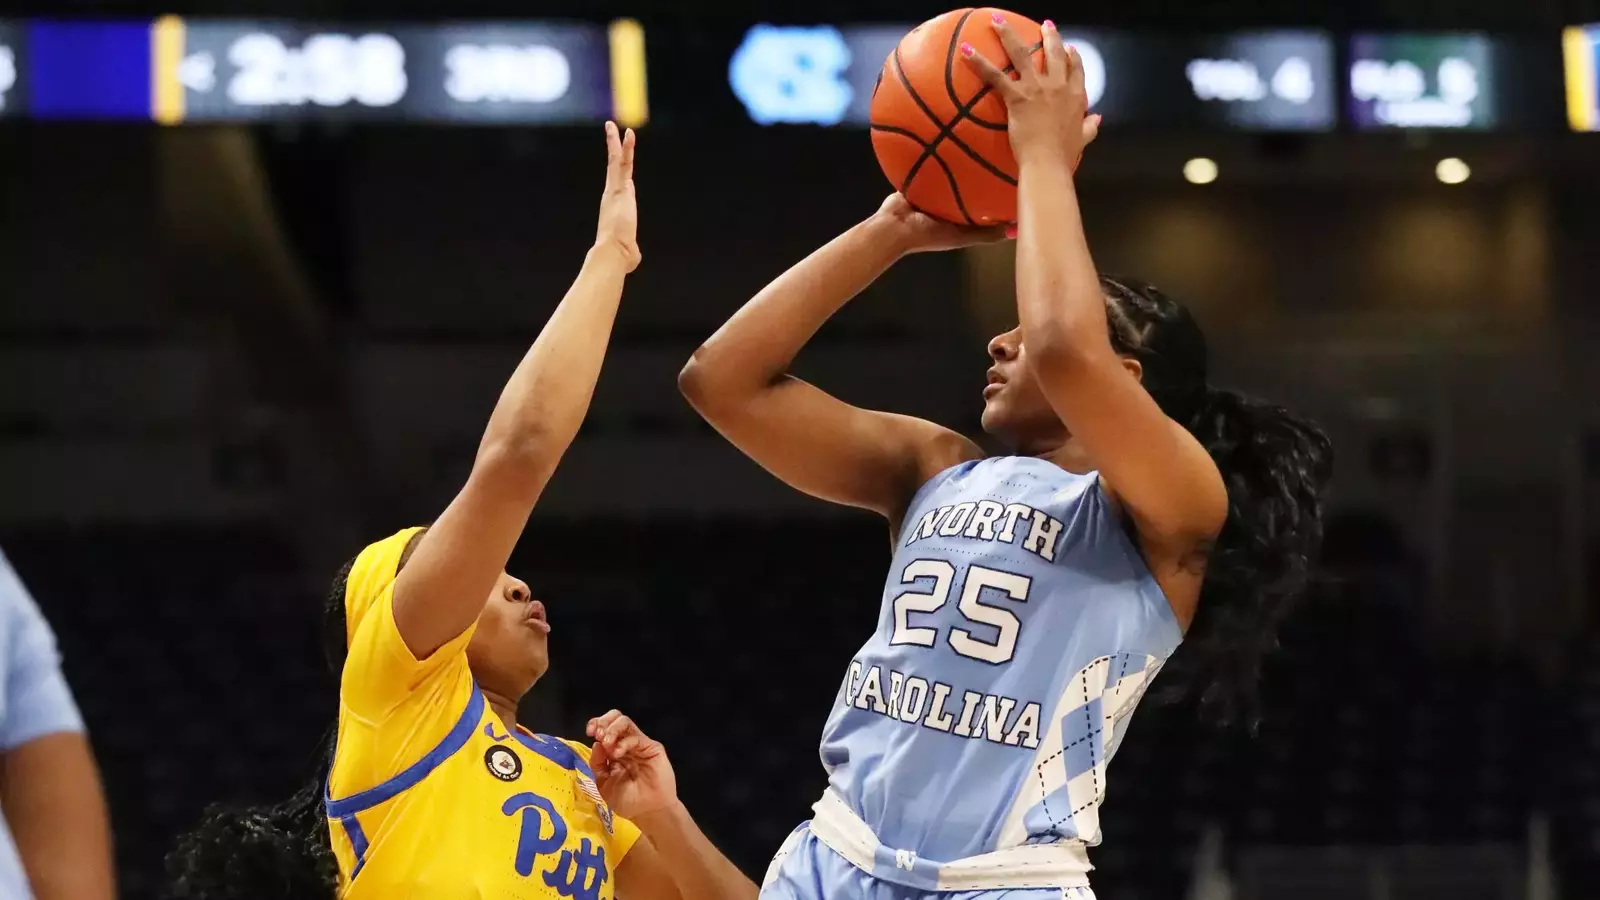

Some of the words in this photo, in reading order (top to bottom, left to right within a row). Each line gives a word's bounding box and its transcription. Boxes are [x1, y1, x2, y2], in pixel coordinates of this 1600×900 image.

[905, 499, 1064, 563] NORTH
[889, 558, 1033, 664] 25
[845, 660, 1042, 750] CAROLINA
[501, 792, 608, 899] Pitt
